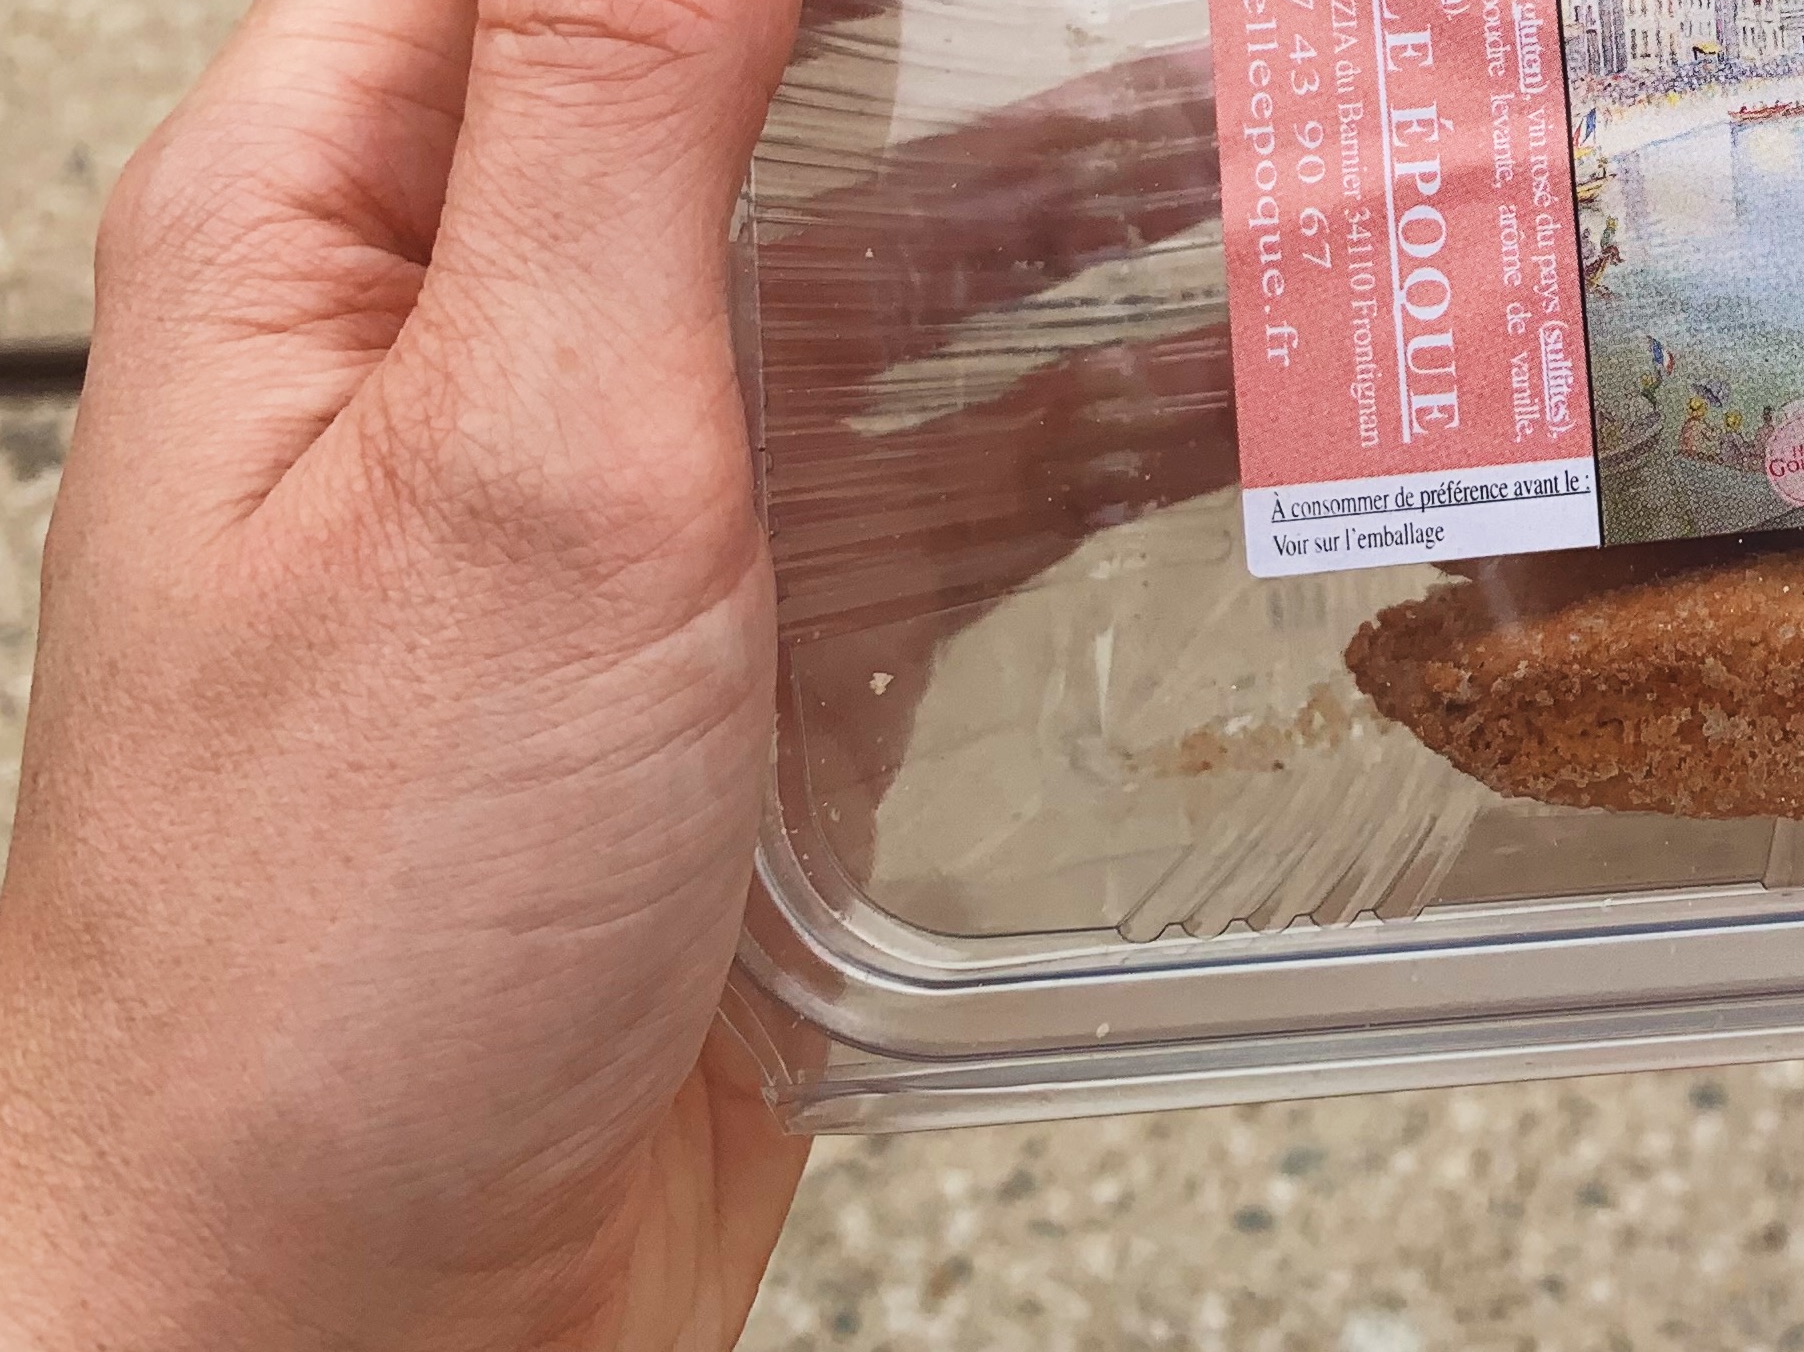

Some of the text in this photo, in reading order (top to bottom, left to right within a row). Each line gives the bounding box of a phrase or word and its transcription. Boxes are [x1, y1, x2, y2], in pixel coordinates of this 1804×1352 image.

[1287, 35, 1321, 95] 43
[1333, 58, 1362, 94] du
[1293, 120, 1326, 185] 90
[1338, 103, 1371, 201] Barnier
[1526, 108, 1550, 146] vin
[1527, 154, 1557, 208] rosé
[1300, 207, 1332, 270] 67
[1344, 208, 1377, 292] 34110
[1496, 204, 1528, 286] arôme
[1532, 212, 1562, 248] du
[1389, 100, 1461, 436] ÉPOQUE
[1527, 251, 1562, 314] pays
[1504, 302, 1531, 334] de
[1350, 296, 1382, 448] Frontignan
[1271, 491, 1287, 522] À
[1291, 491, 1390, 518] consommer
[1394, 486, 1416, 508] de
[1419, 478, 1509, 512] préférence
[1513, 474, 1560, 497] avant
[1563, 469, 1581, 494] le
[1273, 532, 1309, 557] Voir
[1314, 535, 1341, 555] sur
